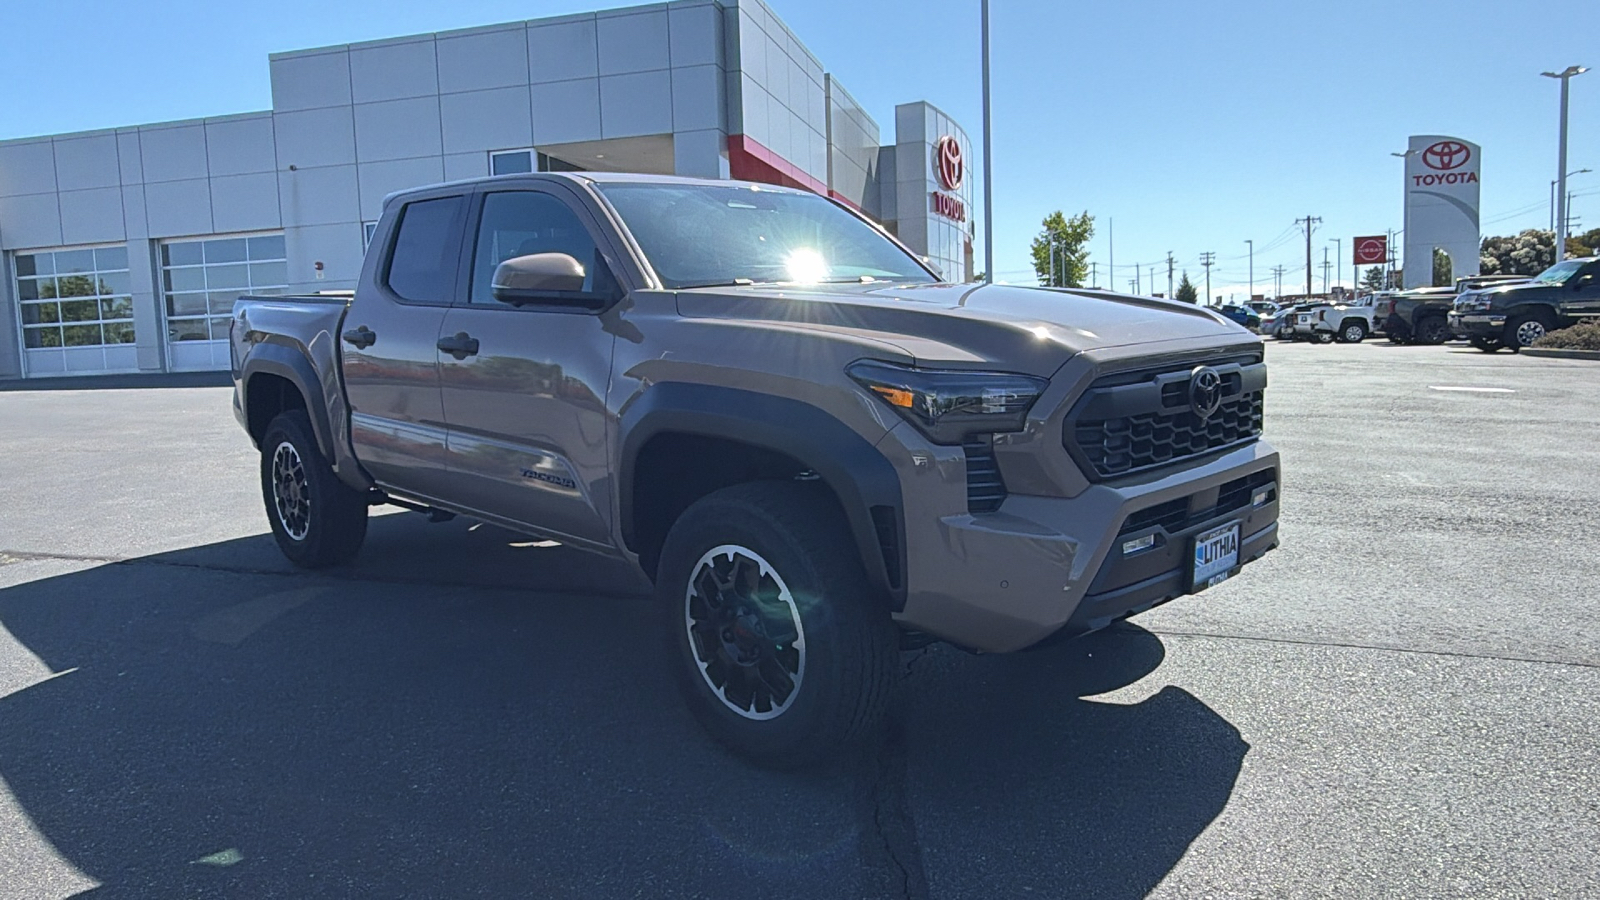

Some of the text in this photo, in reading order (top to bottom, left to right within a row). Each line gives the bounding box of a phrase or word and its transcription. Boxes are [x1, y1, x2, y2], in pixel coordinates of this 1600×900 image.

[1412, 171, 1478, 187] TOYOTA
[519, 468, 576, 489] TACOMA
[1204, 533, 1237, 565] LITHIA
